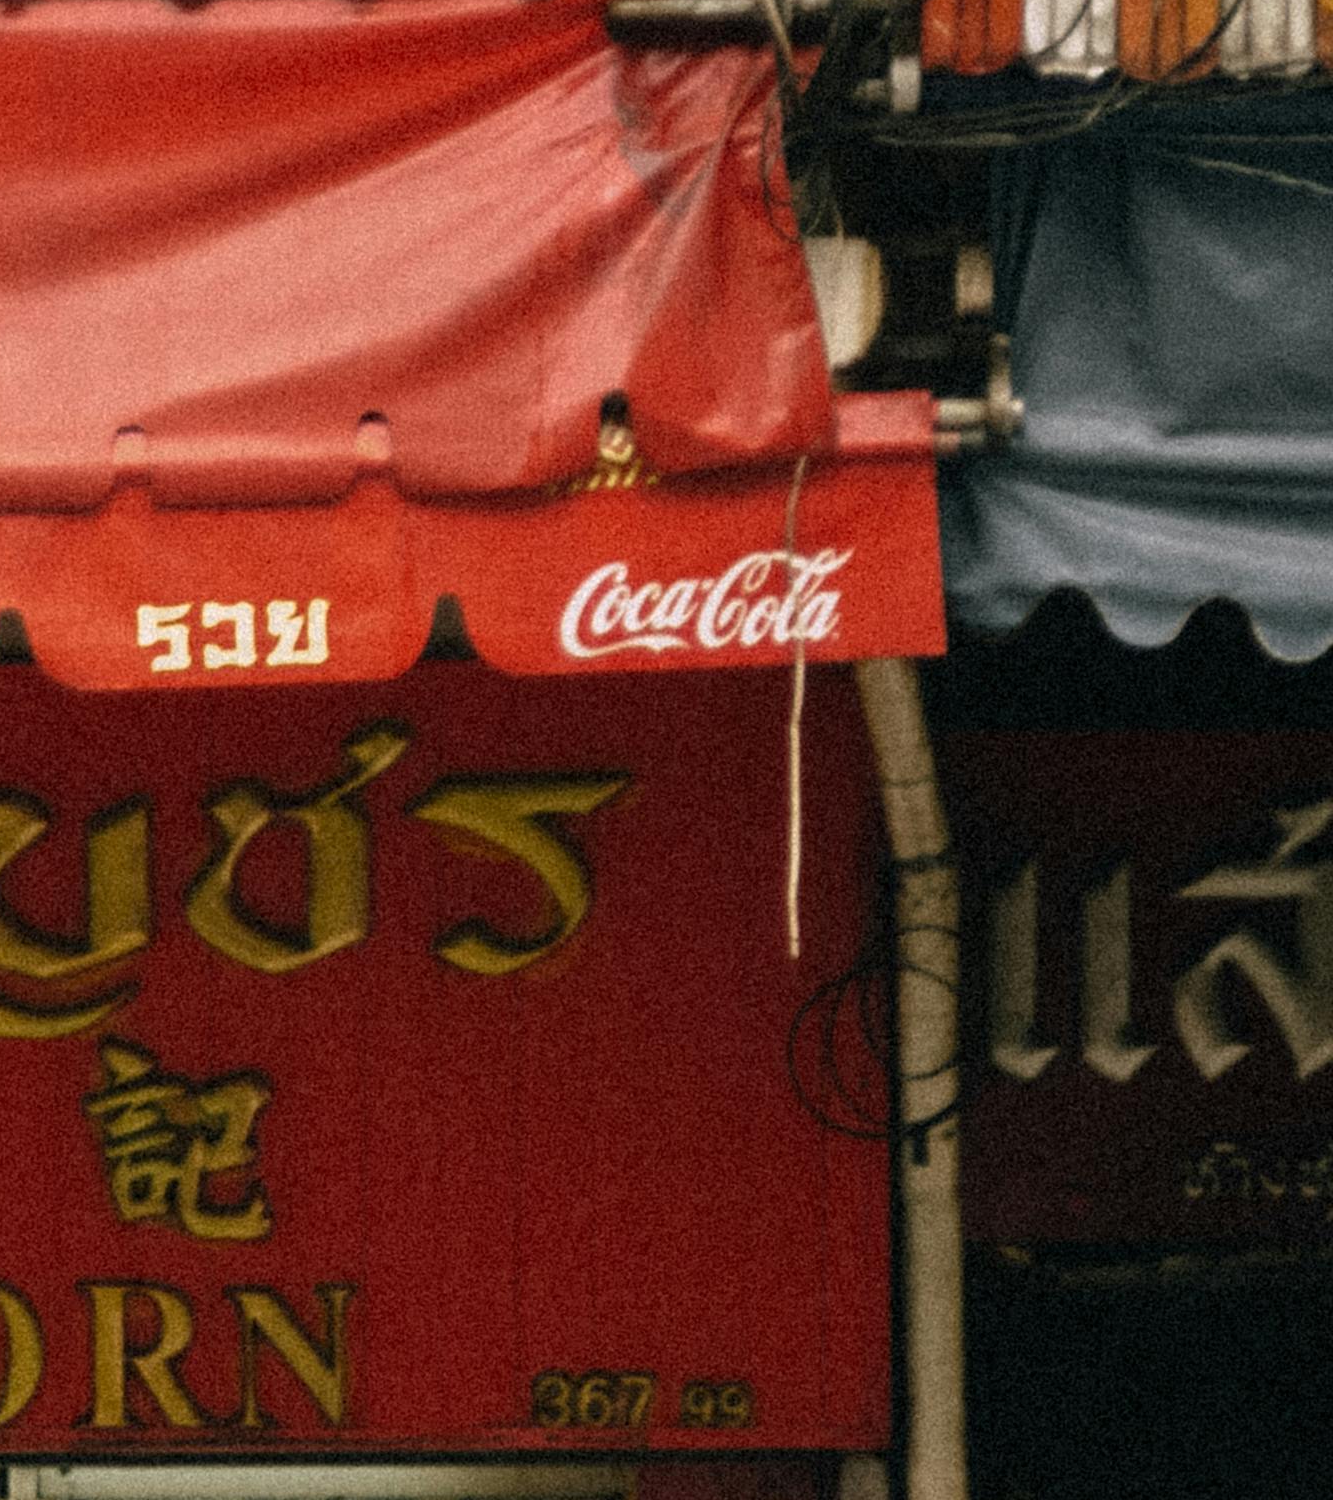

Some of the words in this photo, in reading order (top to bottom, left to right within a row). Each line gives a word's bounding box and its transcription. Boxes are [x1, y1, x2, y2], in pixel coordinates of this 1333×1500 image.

[137, 599, 330, 672] รวย
[560, 548, 853, 658] Coca-Cola
[536, 1373, 654, 1428] 367
